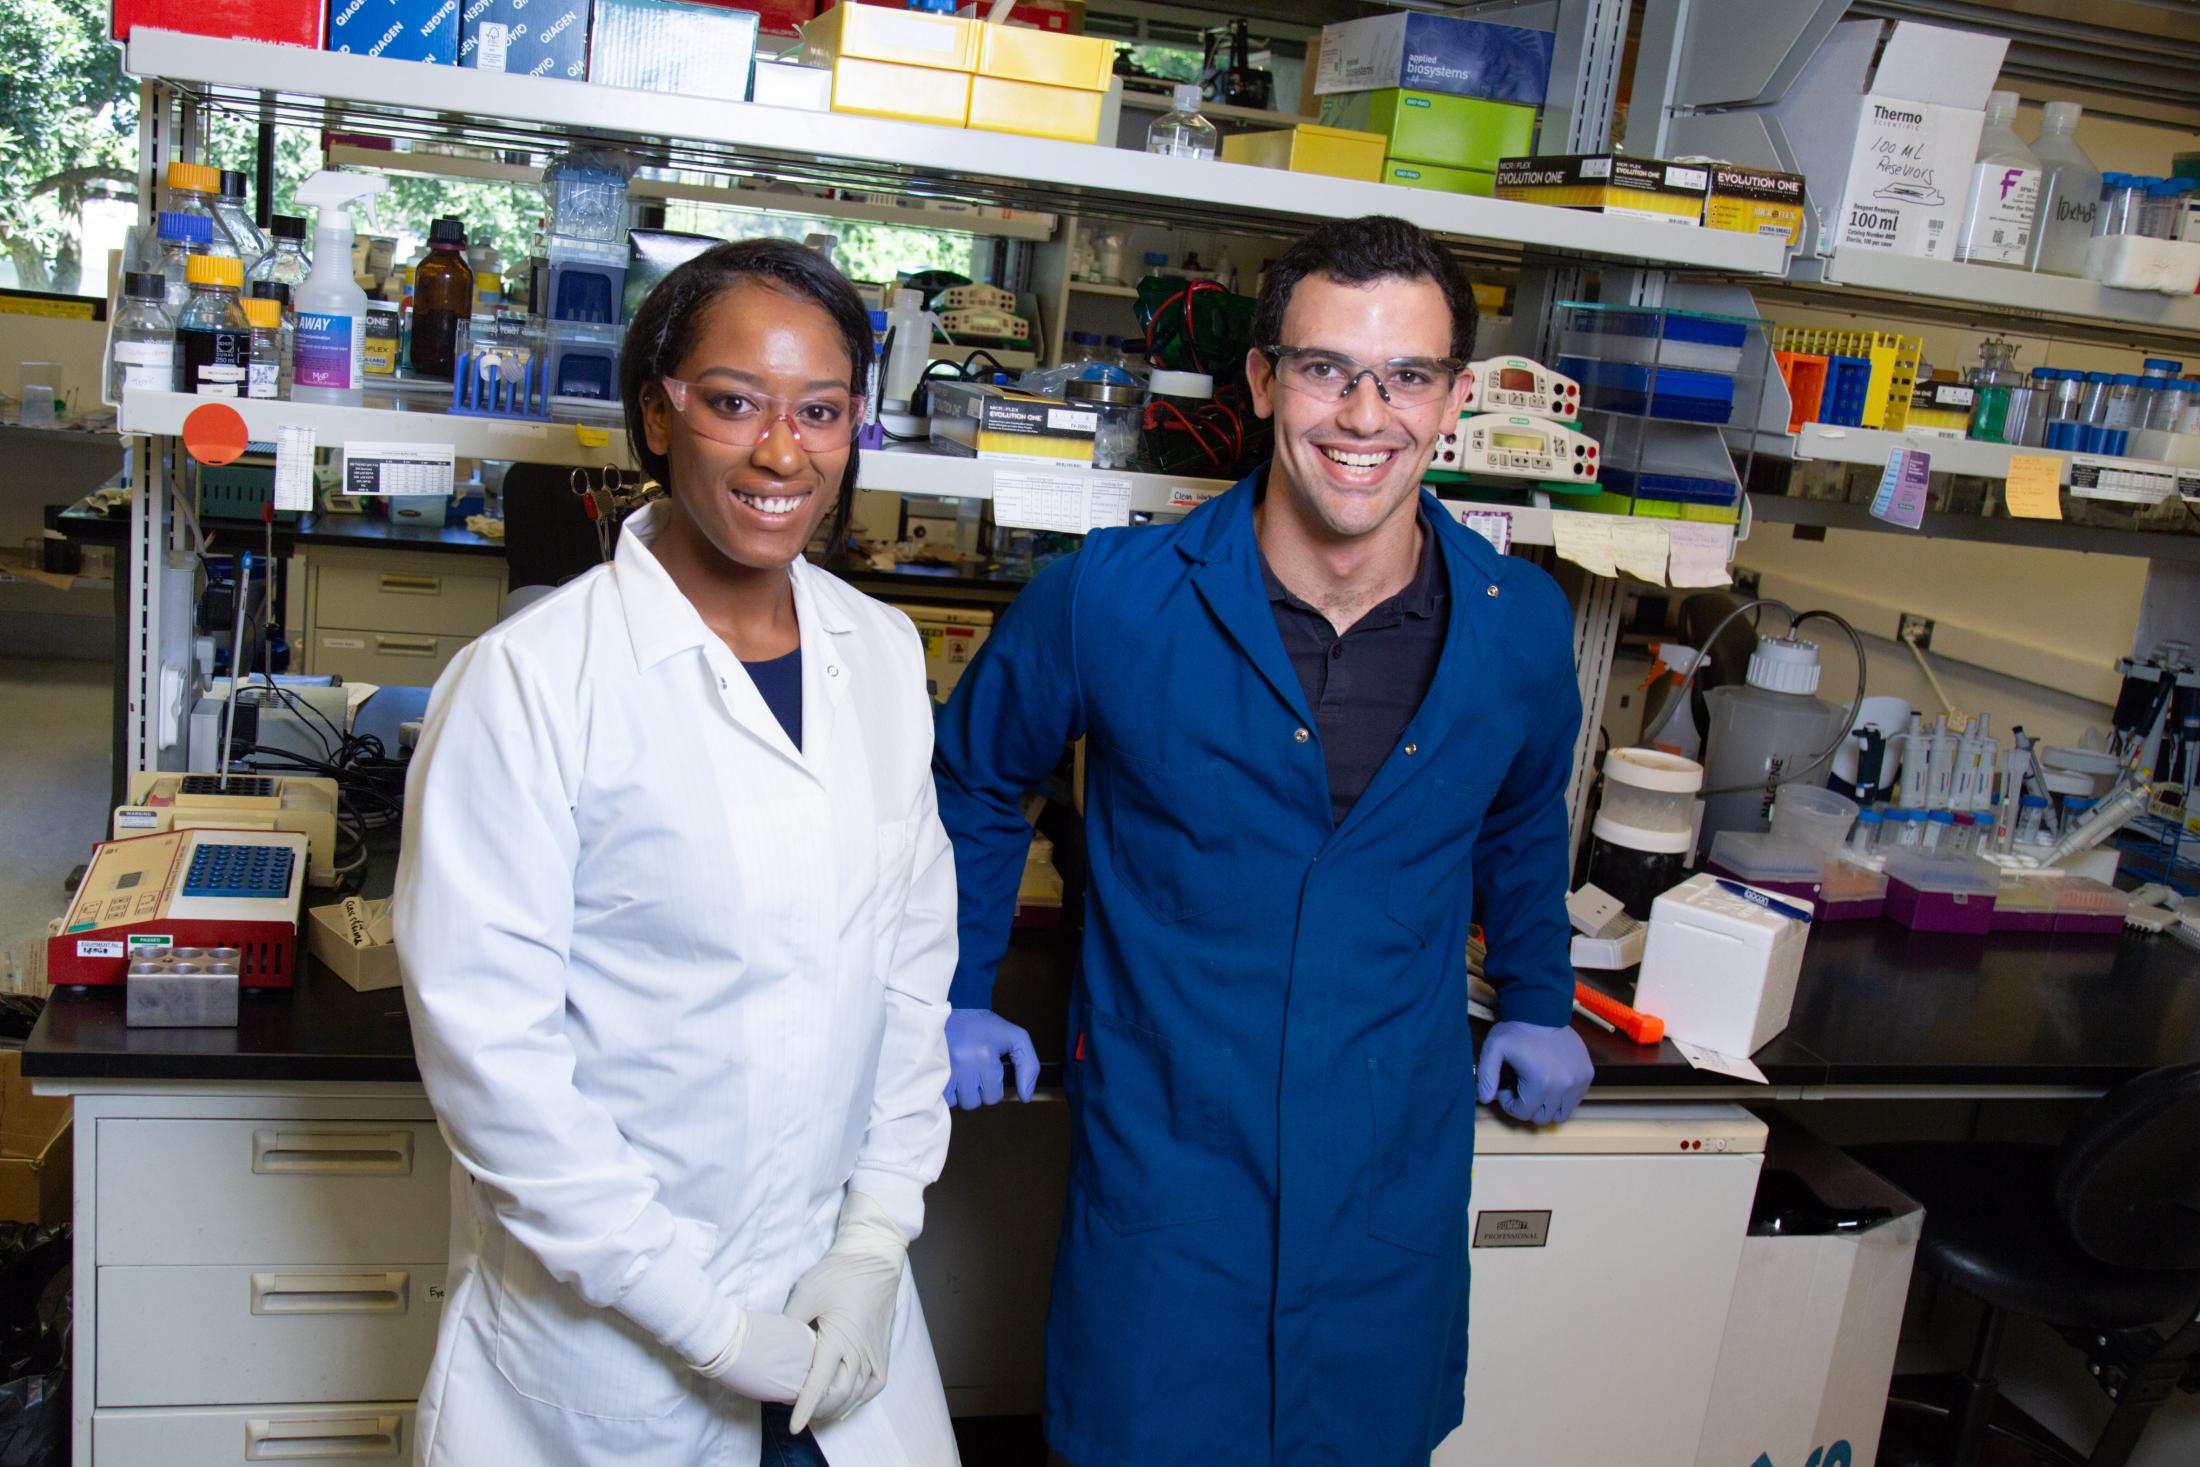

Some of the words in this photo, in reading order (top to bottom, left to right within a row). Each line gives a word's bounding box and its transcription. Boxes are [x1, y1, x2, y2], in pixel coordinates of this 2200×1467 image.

[420, 0, 456, 37] QIAGEN
[540, 10, 577, 44] QIAGEN
[368, 21, 404, 57] QIAGEN
[1408, 54, 1438, 65] applied
[1407, 61, 1469, 80] biosystems
[1874, 105, 1922, 124] Thermo
[1873, 120, 1920, 131] SCIENTIFIC
[1871, 136, 1896, 154] 100
[1498, 171, 1544, 185] EVOLUTION
[1544, 171, 1563, 184] ONE
[1615, 167, 1647, 178] EVOLUTION
[1647, 171, 1660, 179] ONE
[1717, 172, 1776, 188] EVOLUTION
[1777, 180, 1799, 192] ONE
[1849, 211, 1877, 229] 100
[1878, 216, 1898, 231] ml
[299, 316, 331, 331] AWAY
[366, 316, 390, 326] ONE
[989, 411, 1027, 421] EVOLUTION
[1027, 414, 1042, 422] ONE
[1484, 1232, 1537, 1240] PROFESSIONAL
